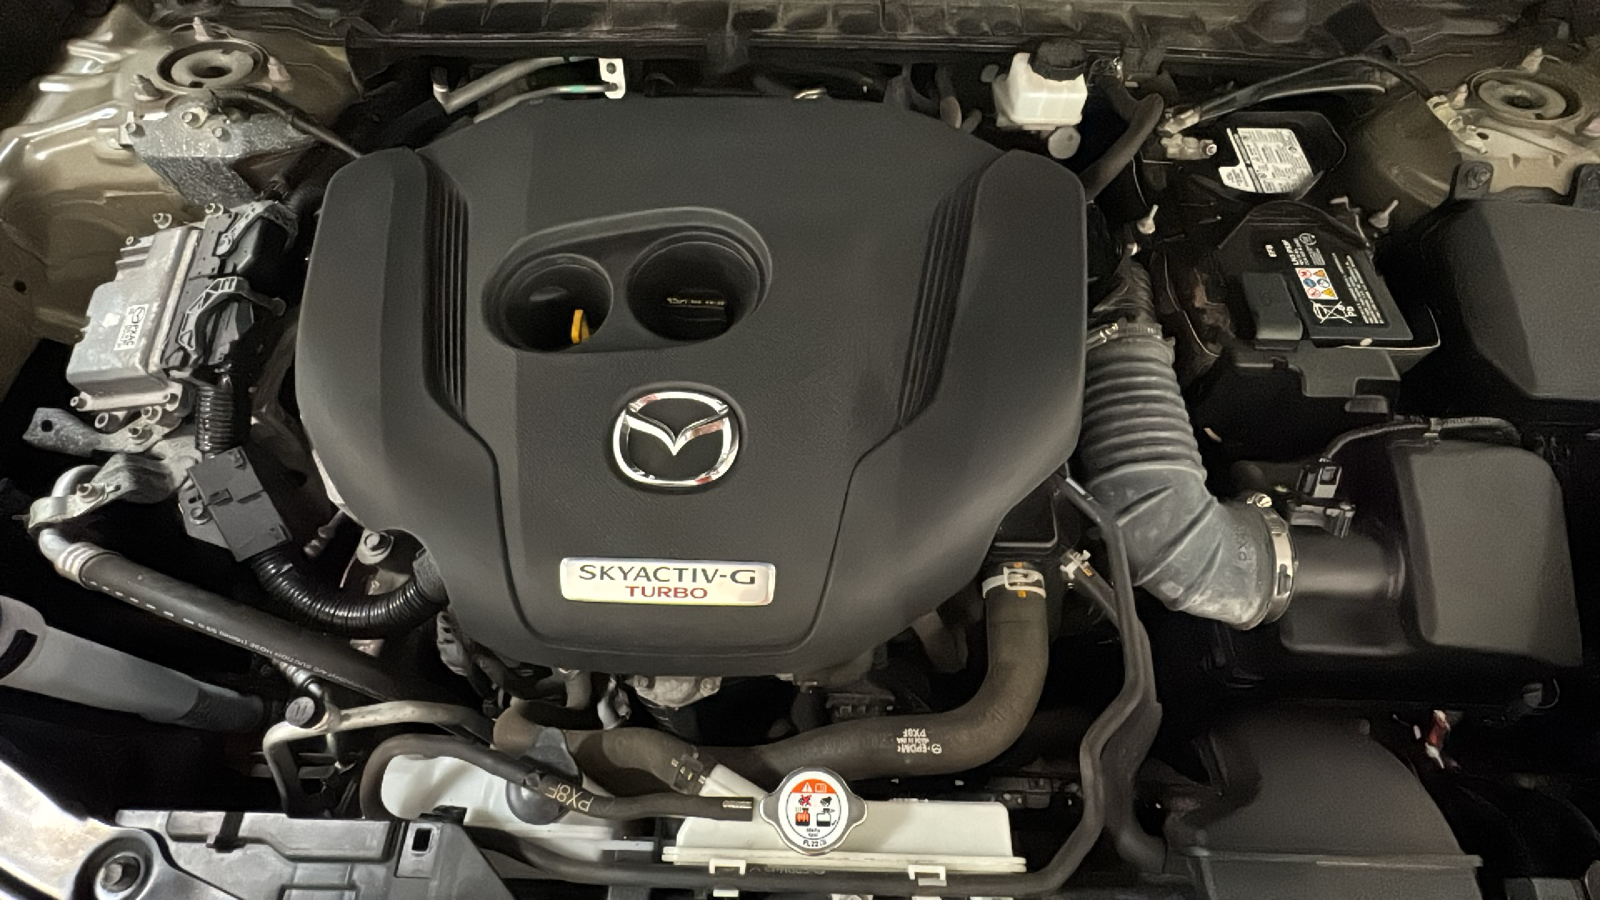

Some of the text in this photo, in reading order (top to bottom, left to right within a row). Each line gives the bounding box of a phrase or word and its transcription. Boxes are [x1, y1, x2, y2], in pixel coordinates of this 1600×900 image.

[578, 564, 757, 586] SKYACTIV-G
[625, 586, 709, 599] TURBO
[249, 642, 273, 655] HOSE
[274, 651, 312, 669] SUCTION
[544, 783, 595, 813] PX8F
